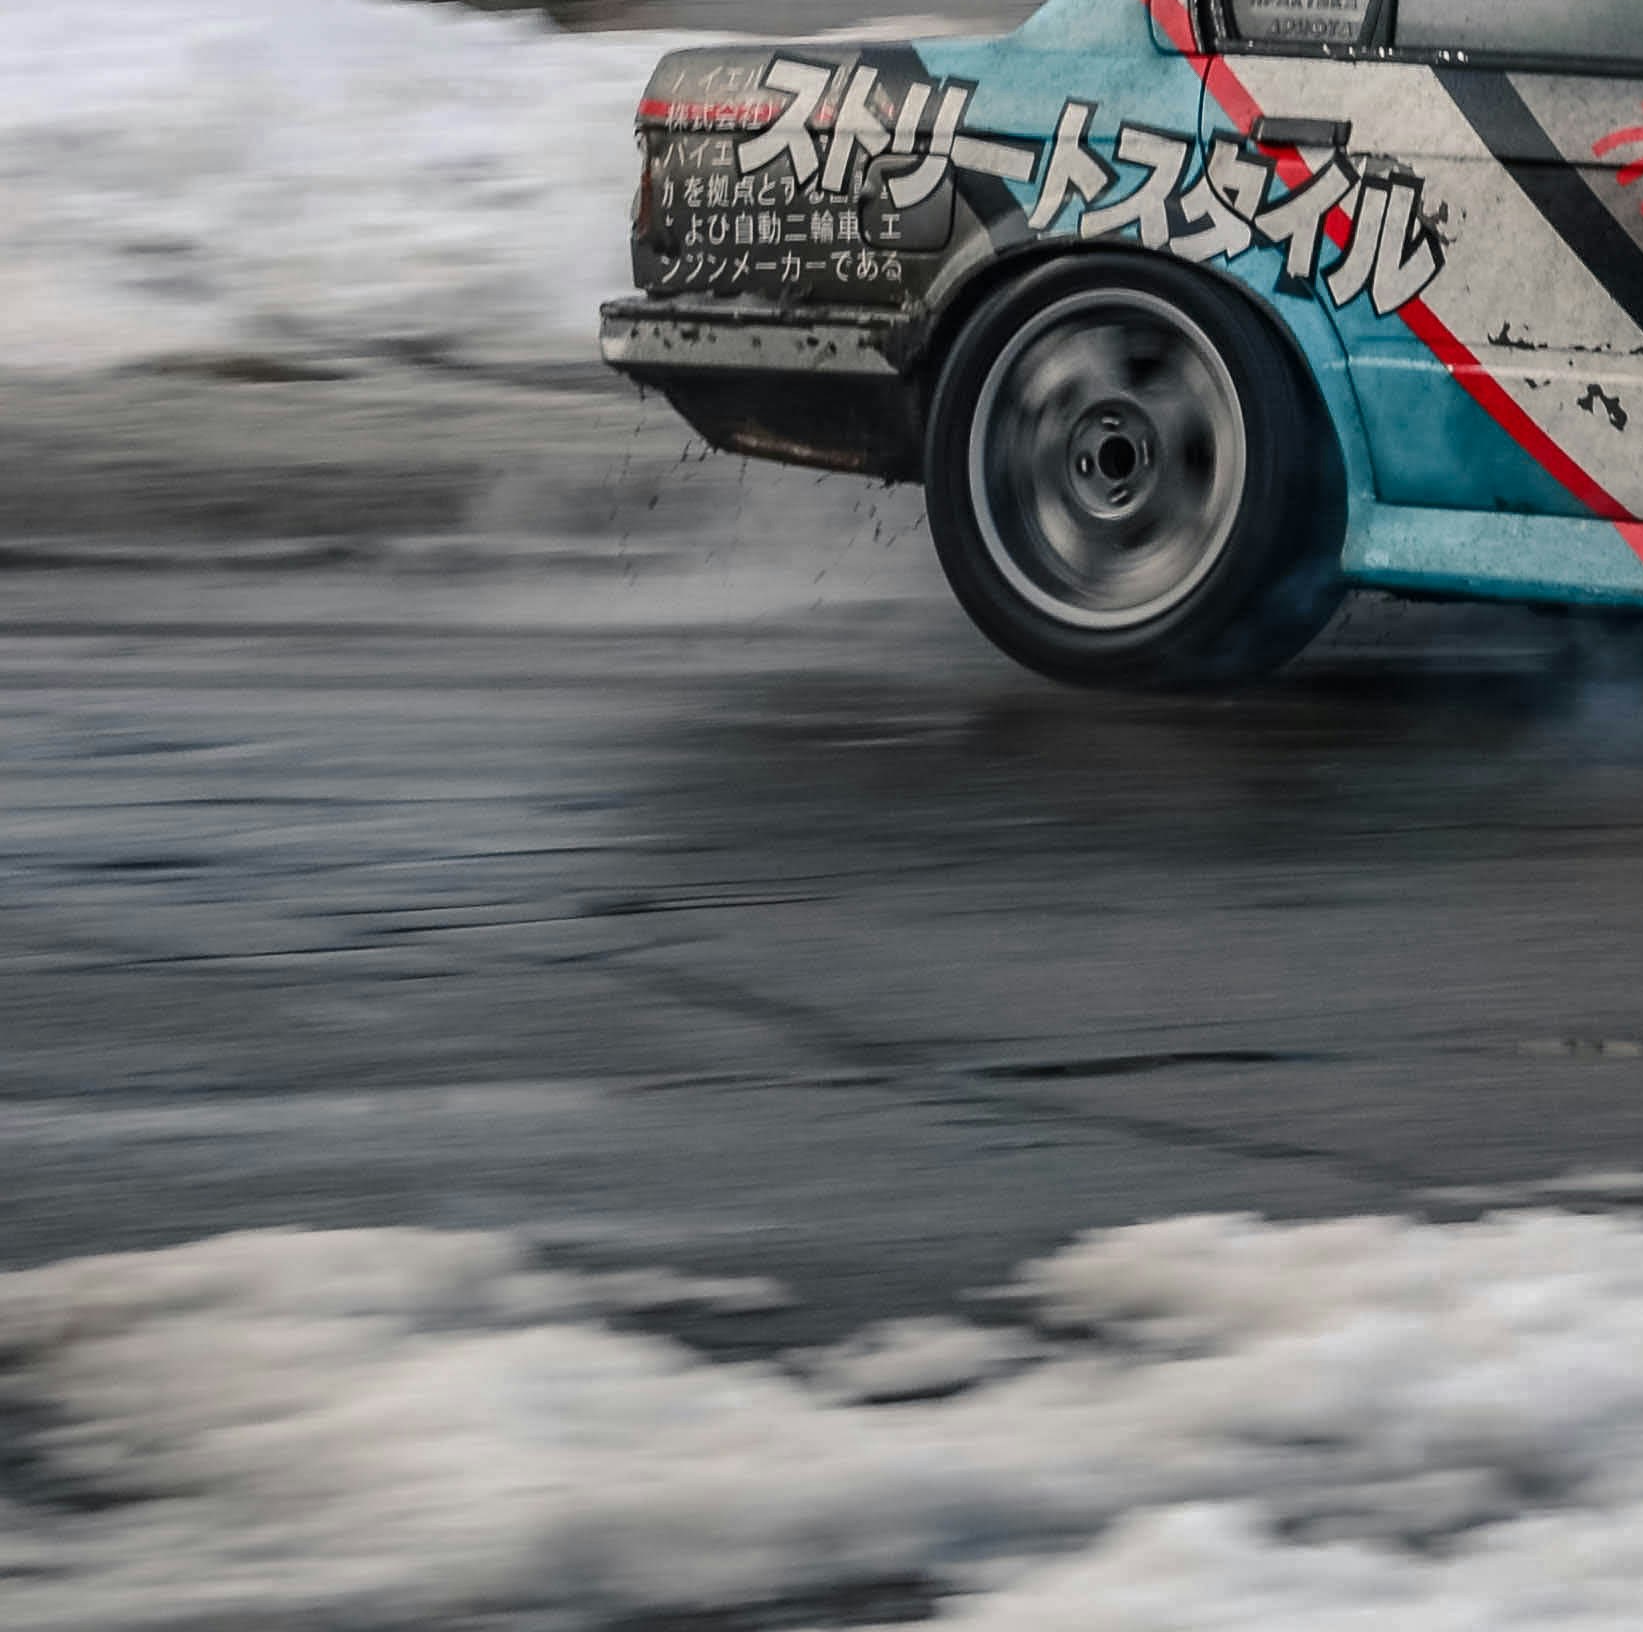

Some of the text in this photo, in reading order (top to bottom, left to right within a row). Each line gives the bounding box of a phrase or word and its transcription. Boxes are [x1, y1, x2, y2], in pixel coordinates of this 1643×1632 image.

[738, 58, 1444, 314] ストリートスタイル
